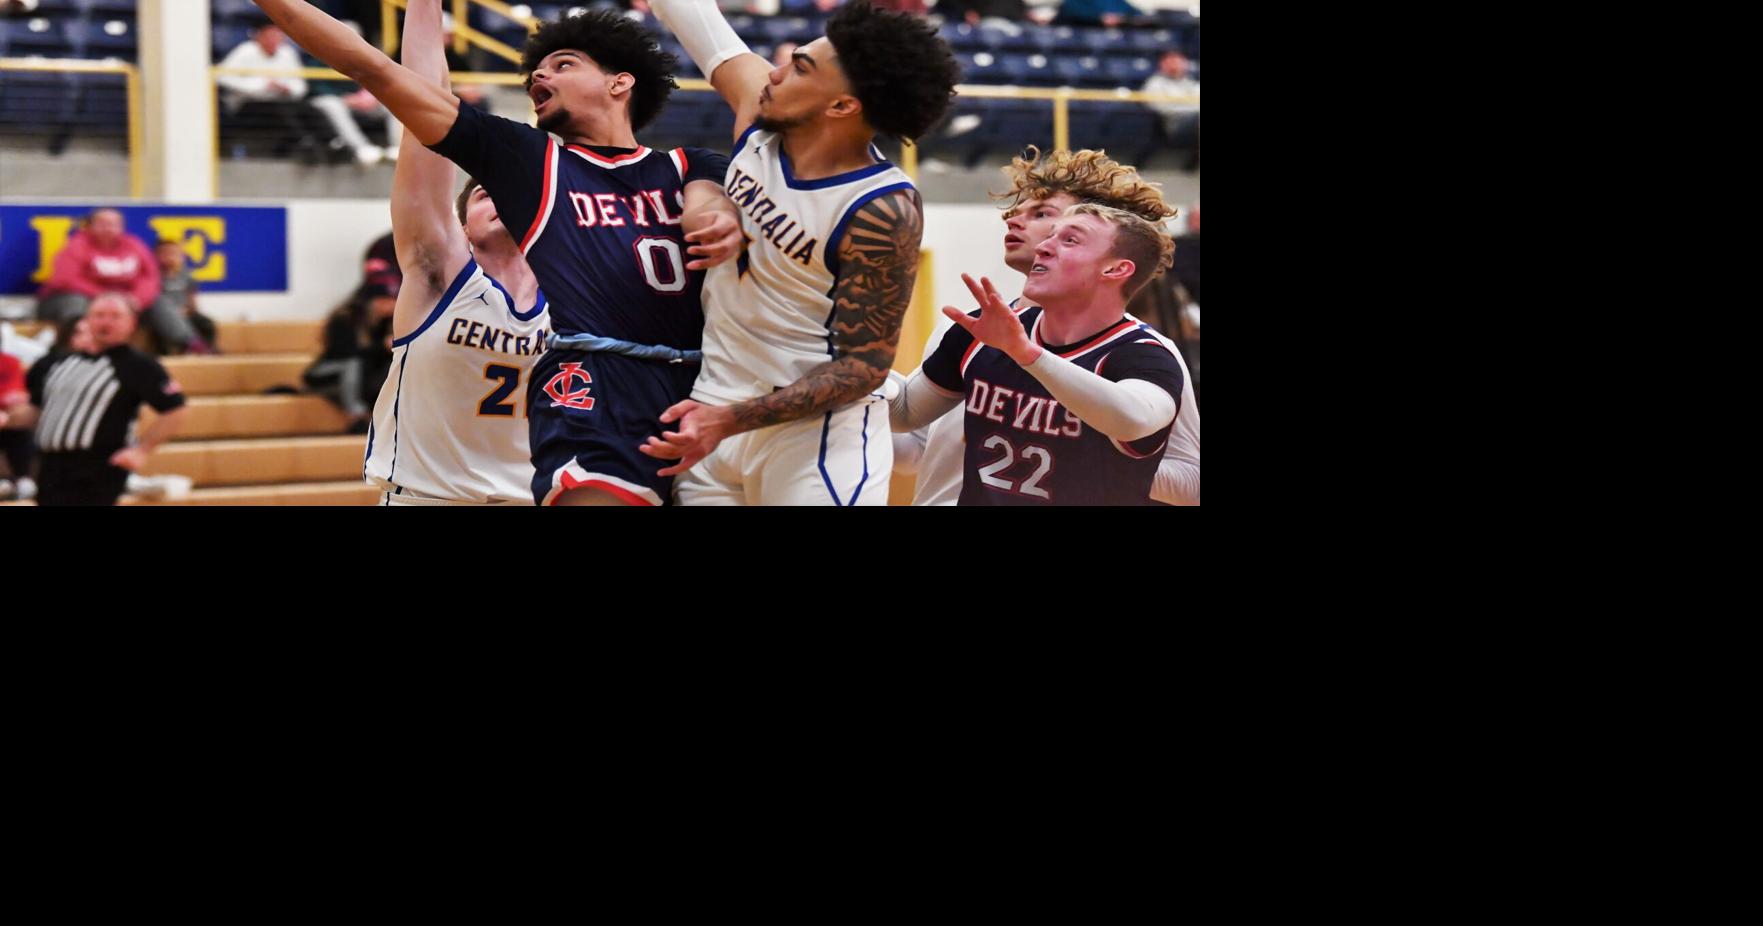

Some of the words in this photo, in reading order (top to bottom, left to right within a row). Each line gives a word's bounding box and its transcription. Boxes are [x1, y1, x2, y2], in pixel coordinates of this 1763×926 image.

[726, 168, 818, 266] CENRALIA
[634, 235, 688, 294] 0
[446, 317, 549, 357] CENTRA
[476, 361, 530, 418] 2
[966, 378, 1083, 438] DEVILS
[977, 434, 1052, 500] 22
